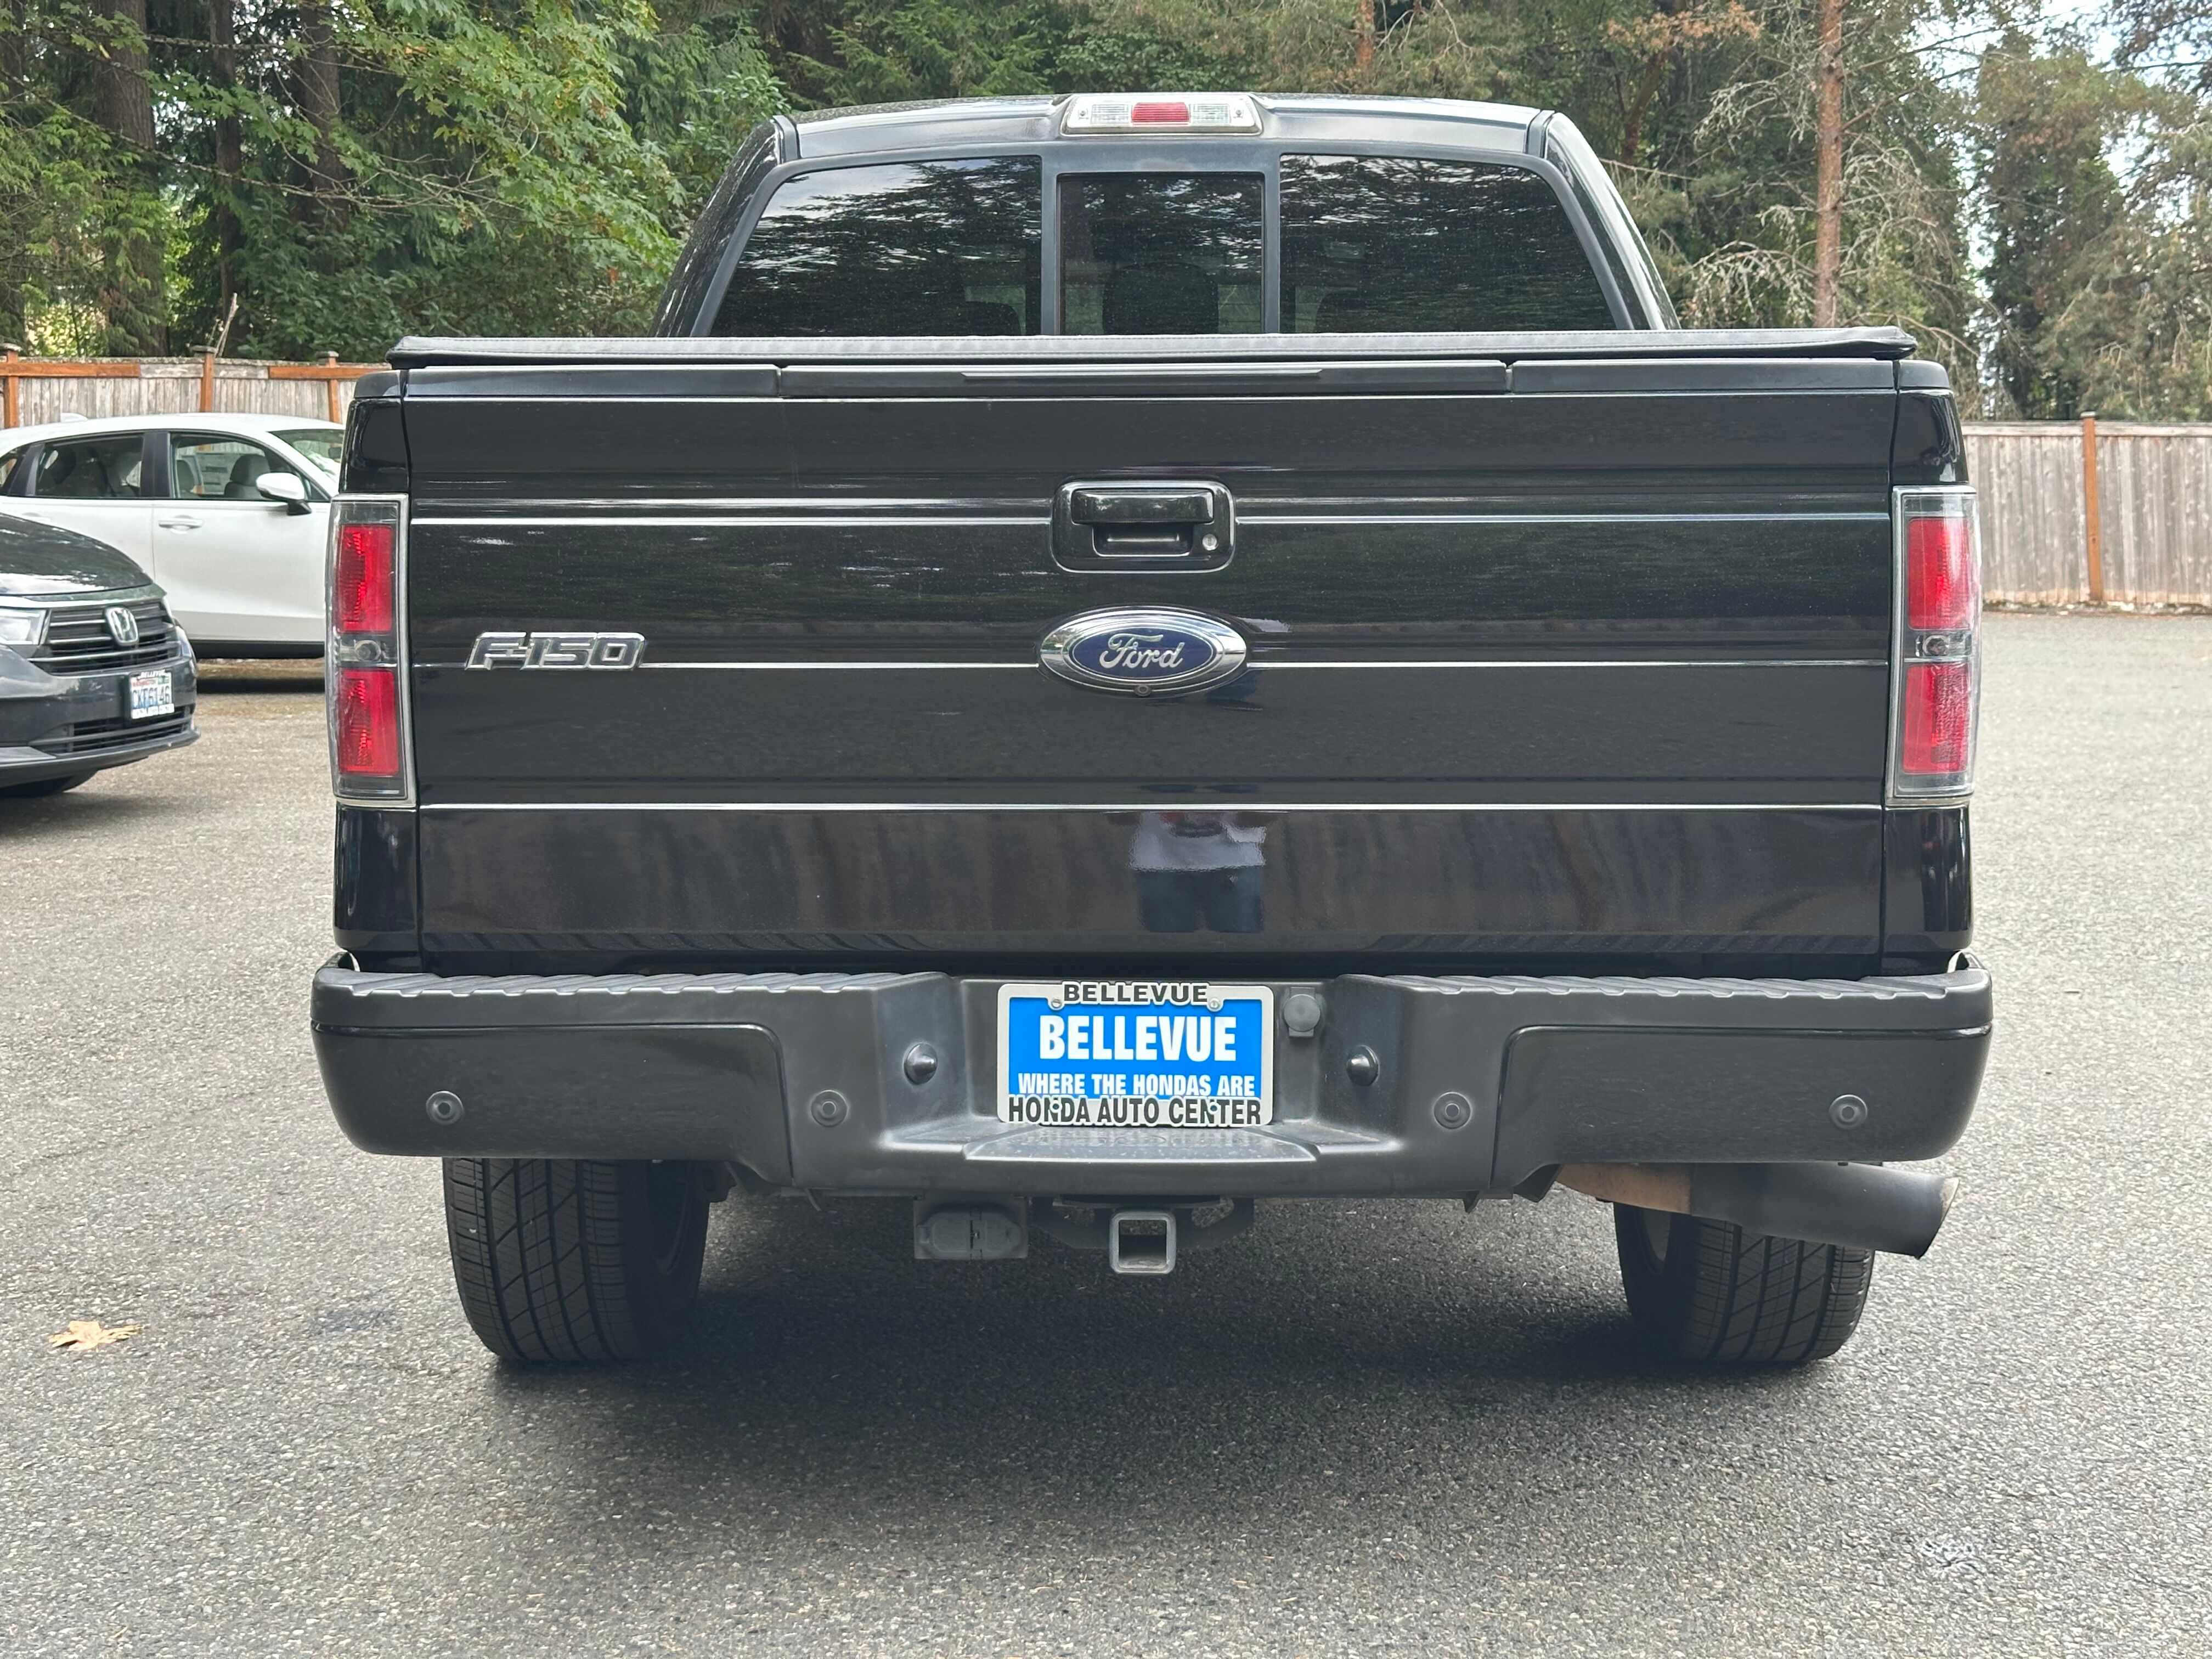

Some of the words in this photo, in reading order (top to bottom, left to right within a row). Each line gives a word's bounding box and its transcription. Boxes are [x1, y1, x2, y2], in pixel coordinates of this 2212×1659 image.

[465, 631, 645, 670] F-150
[1099, 633, 1185, 668] Ford
[1063, 984, 1209, 1003] BELLEVUE
[1039, 1015, 1237, 1062] BELLEVUE
[1018, 1073, 1085, 1095] WHERE
[1091, 1074, 1126, 1096] THE
[1133, 1074, 1211, 1096] HONDAS
[1217, 1075, 1255, 1096] ARE
[1008, 1097, 1091, 1124] HONDA
[1097, 1097, 1160, 1124] AUTO
[1168, 1099, 1261, 1125] CENTER
